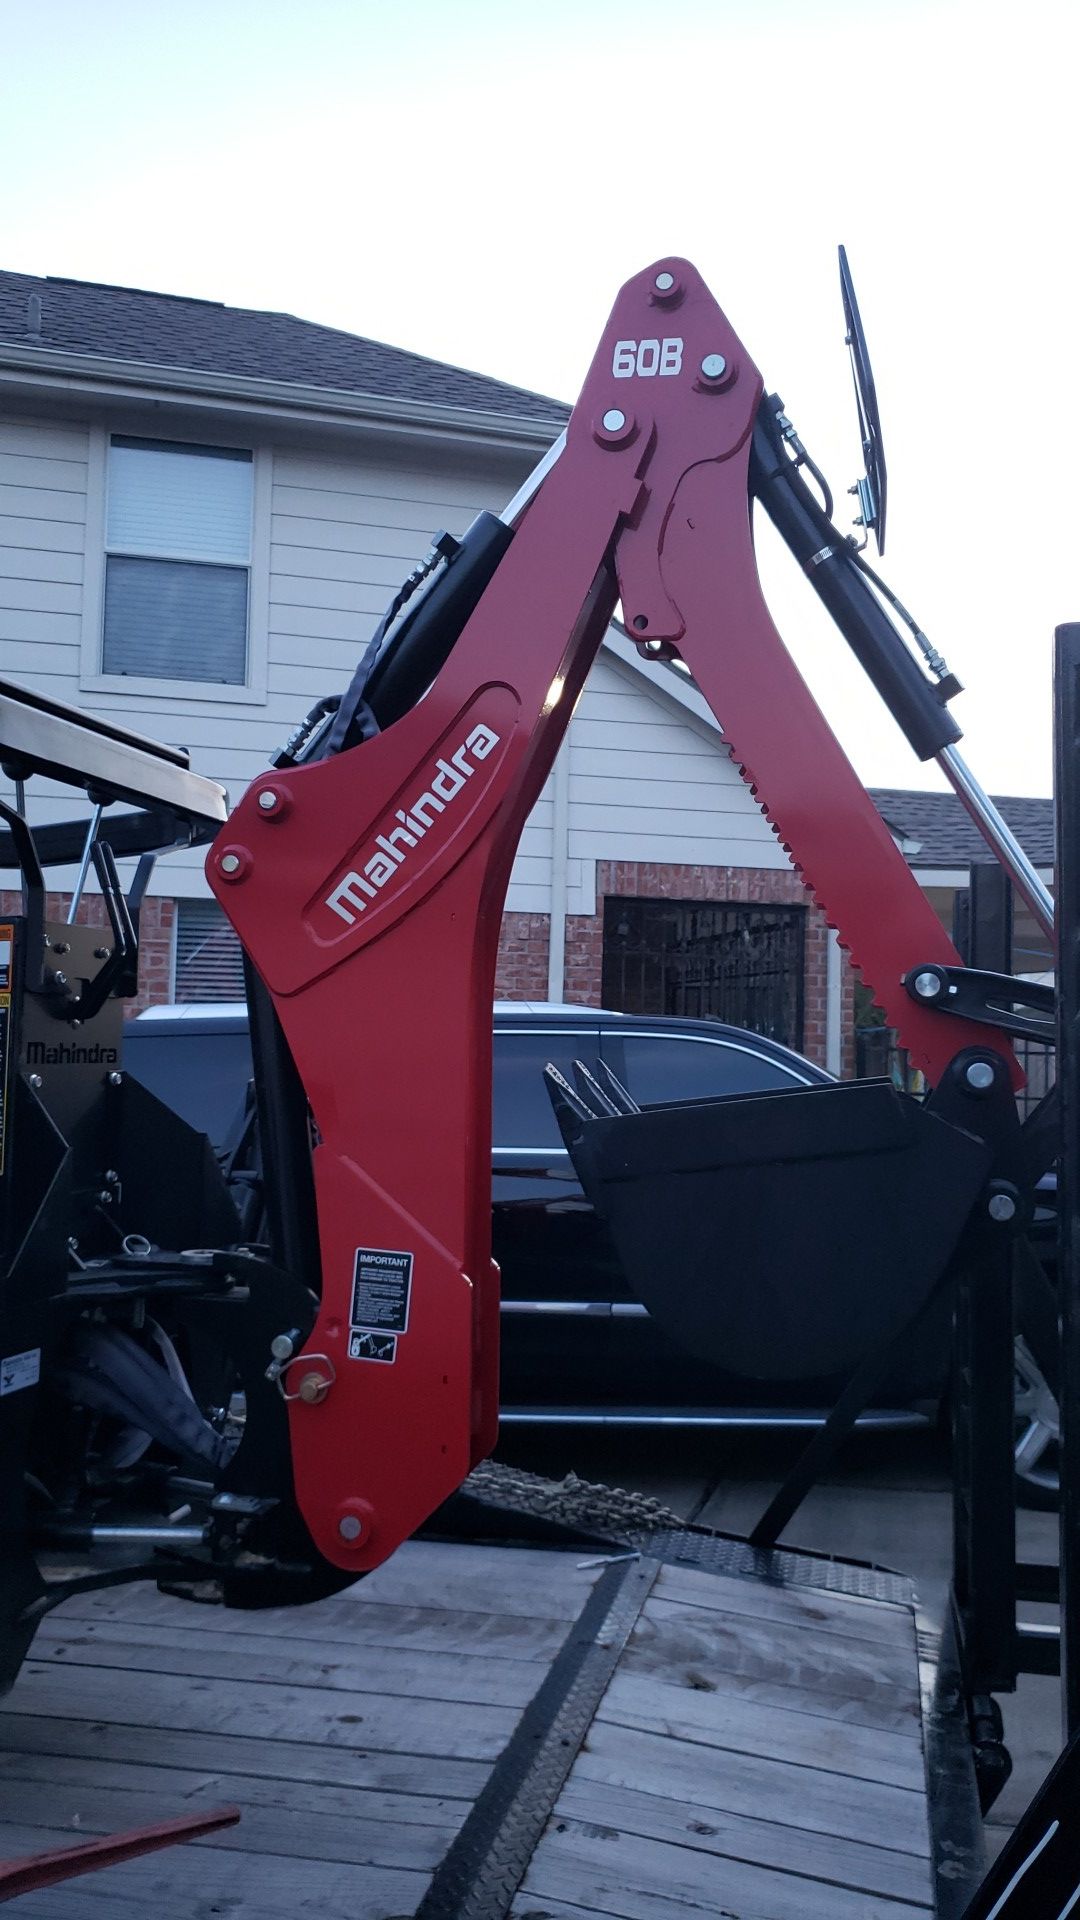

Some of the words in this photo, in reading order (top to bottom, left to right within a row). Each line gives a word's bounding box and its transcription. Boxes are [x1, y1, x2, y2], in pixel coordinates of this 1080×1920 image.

[612, 337, 684, 378] 60B
[325, 723, 500, 925] Mahindra
[26, 1040, 118, 1065] Mahindra
[360, 1254, 409, 1267] IMPORTANT
